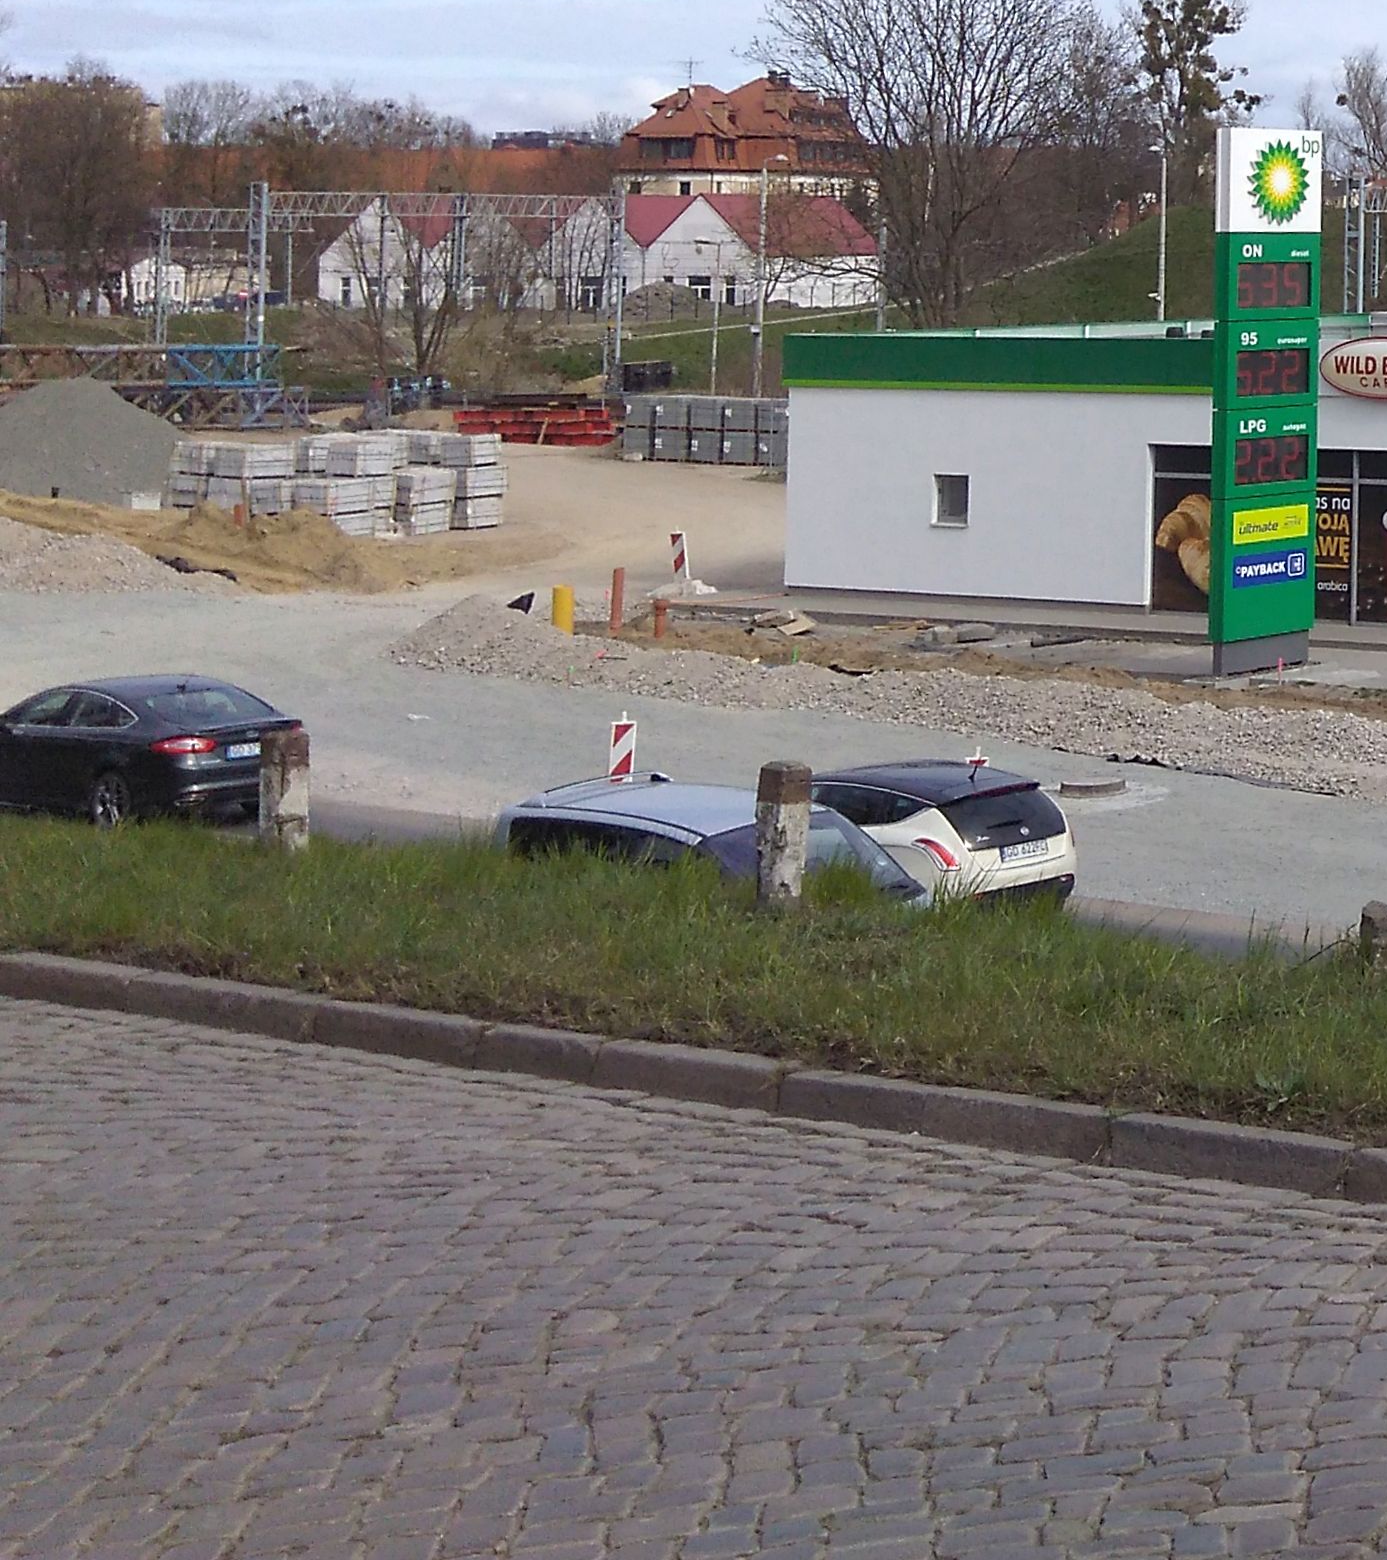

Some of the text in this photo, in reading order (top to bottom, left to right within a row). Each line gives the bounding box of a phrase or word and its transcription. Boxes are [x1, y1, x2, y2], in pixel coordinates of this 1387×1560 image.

[1302, 136, 1320, 157] bp
[1242, 244, 1263, 258] ON
[1241, 332, 1258, 346] 95
[1334, 355, 1377, 375] WILD
[1239, 419, 1266, 434] LPG
[1332, 497, 1350, 510] na
[1316, 513, 1350, 535] OJĄ
[1240, 561, 1286, 578] PAYBACK
[1317, 580, 1348, 592] arabica
